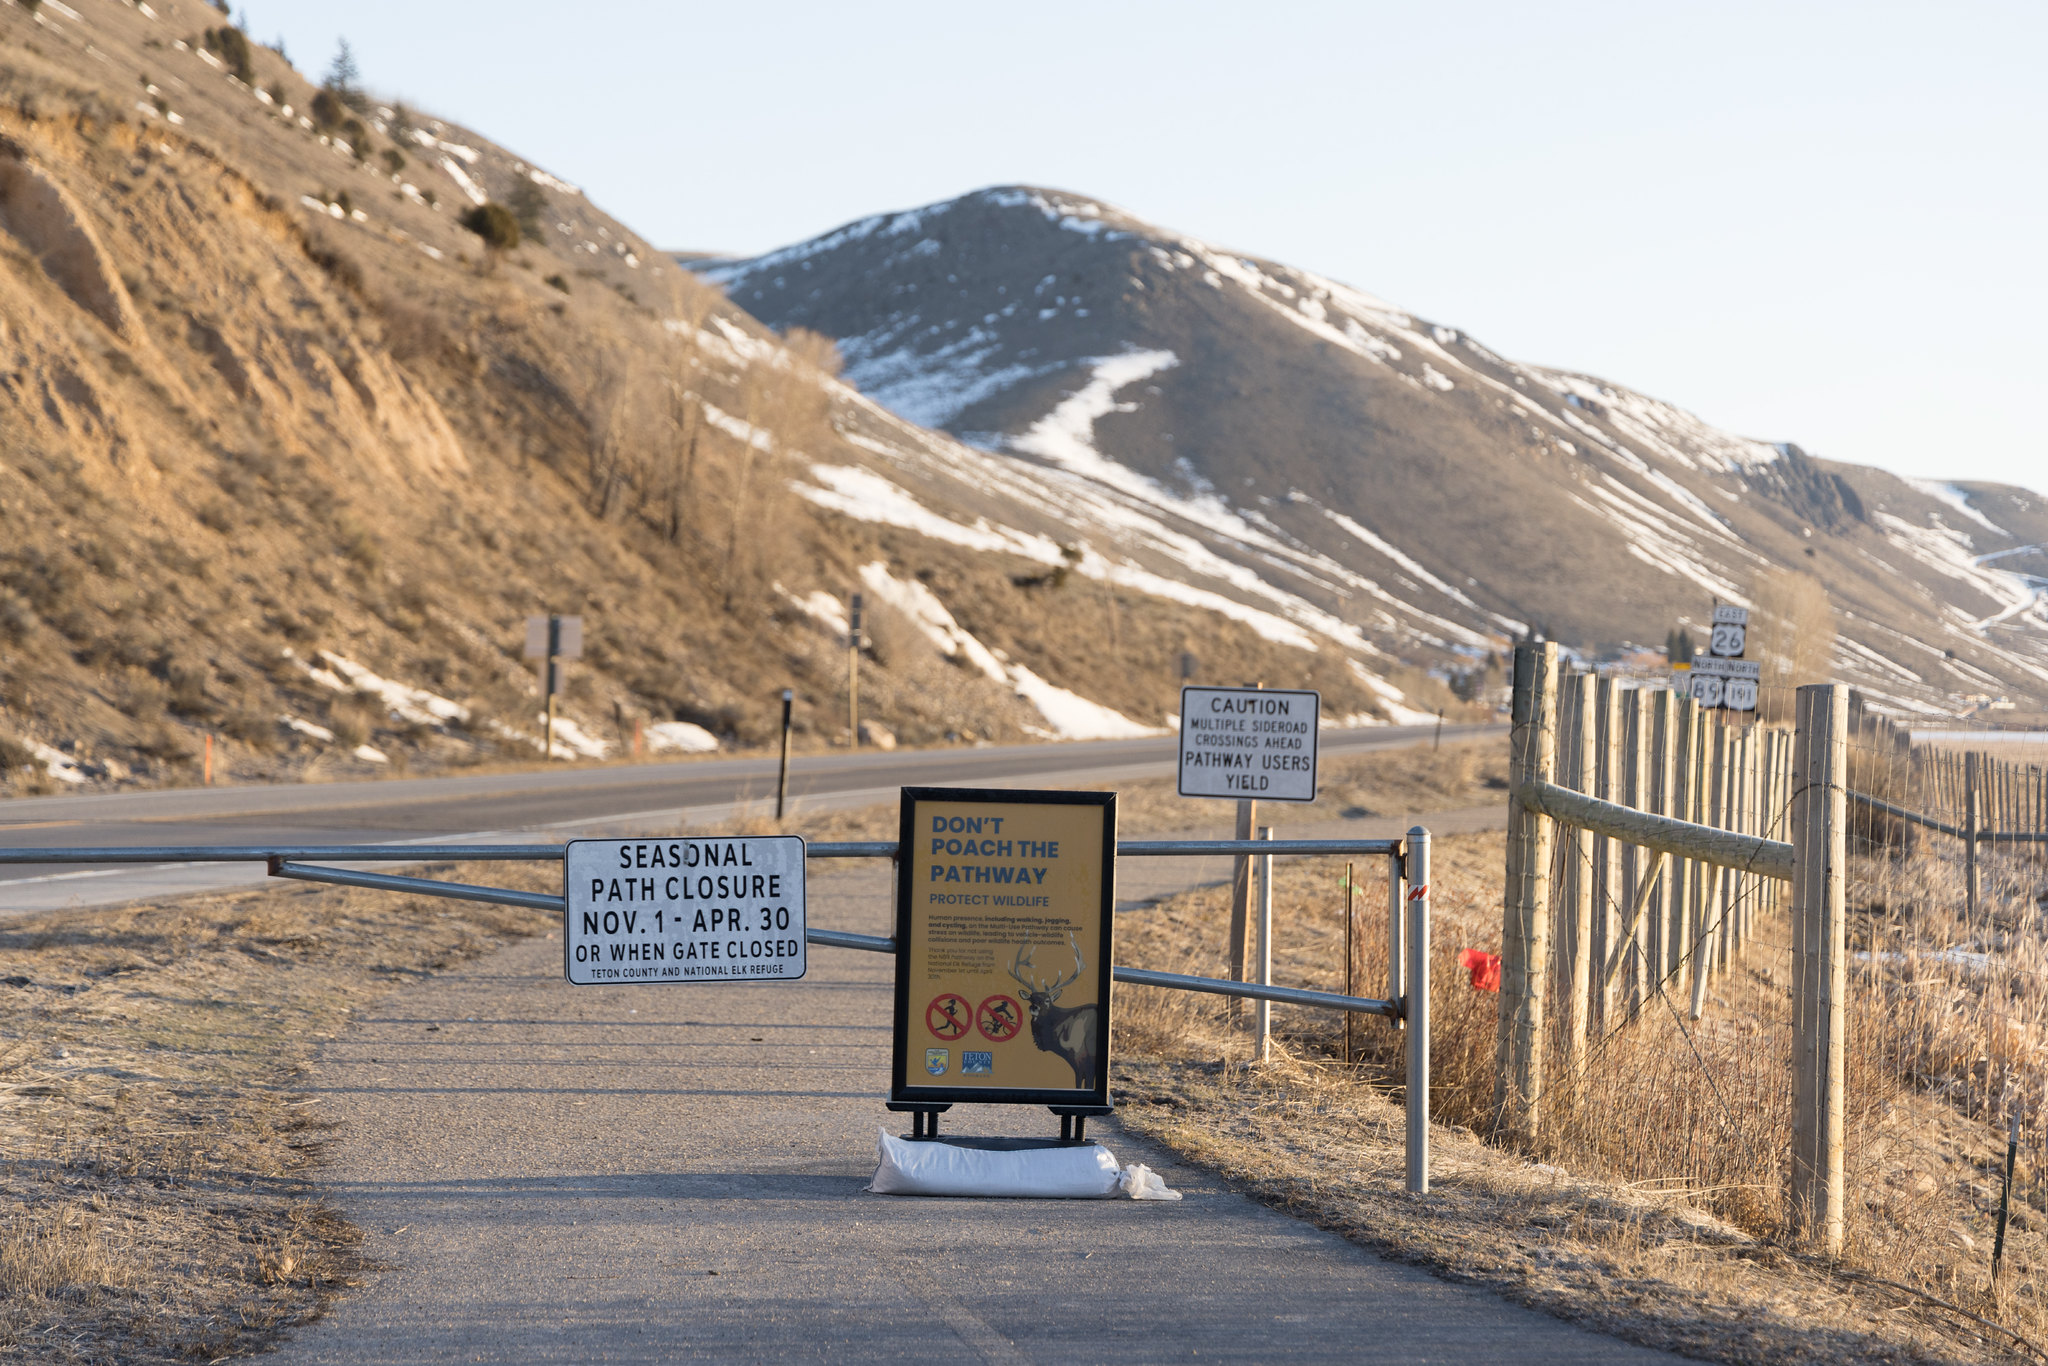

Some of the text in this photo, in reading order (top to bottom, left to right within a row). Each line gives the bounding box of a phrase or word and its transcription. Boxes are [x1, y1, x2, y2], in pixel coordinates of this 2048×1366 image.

[1715, 630, 1741, 649] 26
[1694, 659, 1759, 673] NORTH NORTH
[1694, 681, 1720, 700] 89
[1730, 686, 1752, 700] 191
[1211, 697, 1289, 715] CAUTION
[1191, 718, 1308, 734] MULTIPLE SIDEROAD
[1195, 733, 1302, 750] CROSSINGS AHEAD
[1185, 751, 1310, 771] PATHWAY USERS
[1226, 773, 1269, 791] YIELD
[932, 816, 1004, 834] DON'T
[619, 842, 753, 869] SEASONAL
[931, 838, 1059, 858] POACH THE
[930, 865, 1047, 885] PATHWAY
[591, 874, 781, 902] PATH CLOSURE
[929, 893, 1049, 907] PROTECT WILDLIFE
[583, 910, 646, 935] NOV.
[654, 909, 664, 933] 1
[692, 908, 750, 933] APR.
[760, 906, 790, 931] 30
[575, 939, 798, 962] OR WHEN GATE CLOSED
[591, 964, 784, 979] TETON COUNTY AND NATIONAL ELK REFUGE
[963, 1052, 992, 1061] TETON
